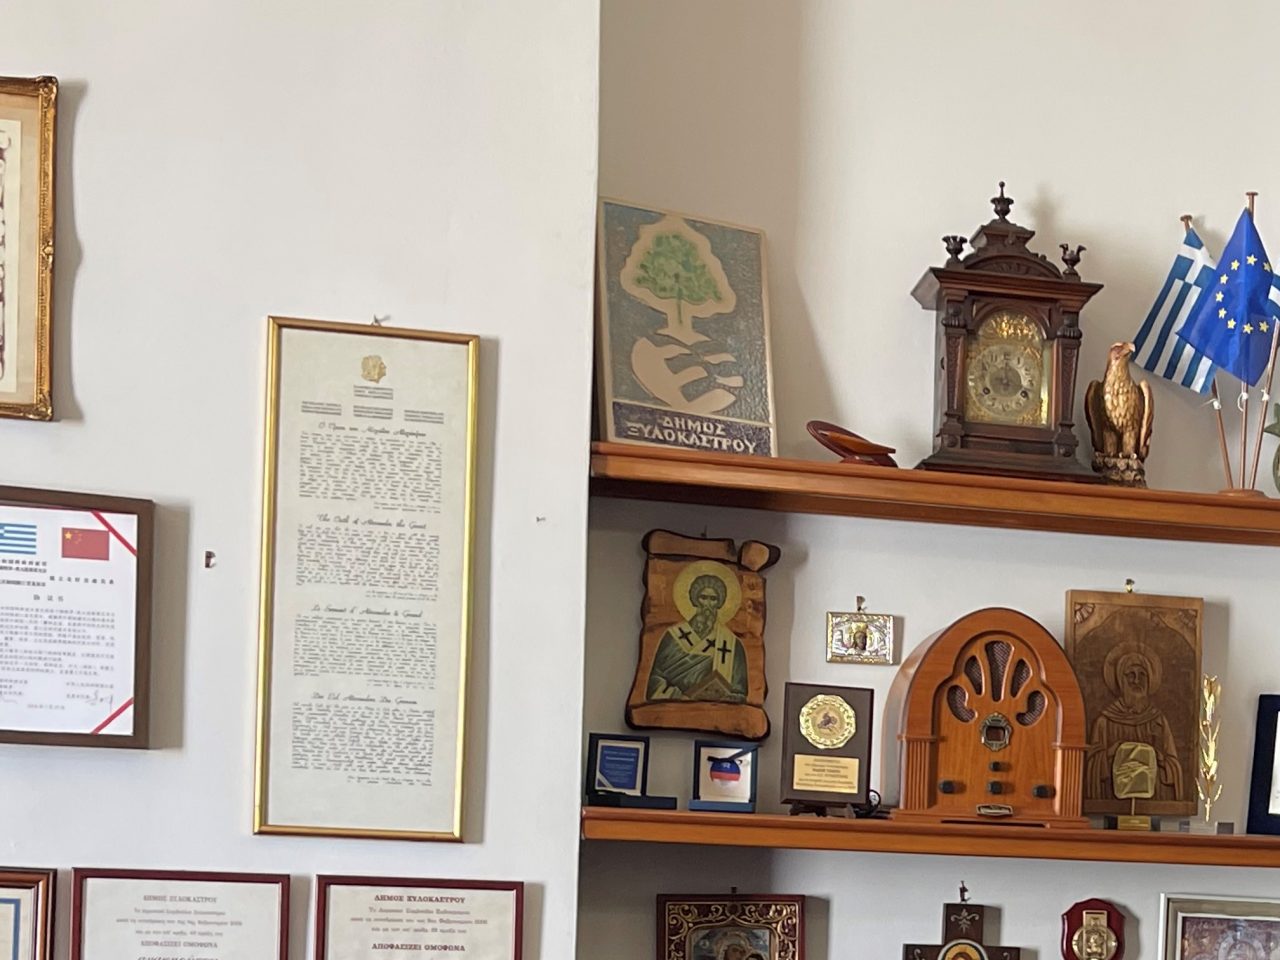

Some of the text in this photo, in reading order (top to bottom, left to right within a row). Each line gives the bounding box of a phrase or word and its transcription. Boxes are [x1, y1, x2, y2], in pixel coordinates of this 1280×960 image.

[661, 416, 727, 436] ΔΗΜΟΣ
[625, 422, 757, 454] ΞΥΛΟΚΑΣΤΡΟΥ
[374, 894, 466, 904] ΔΗΜΟΣ ΞΥΛΟΚΑΣΤΡΟΥ
[371, 943, 422, 951] ΑΠΟΦΑΣΙΖΕΙ
